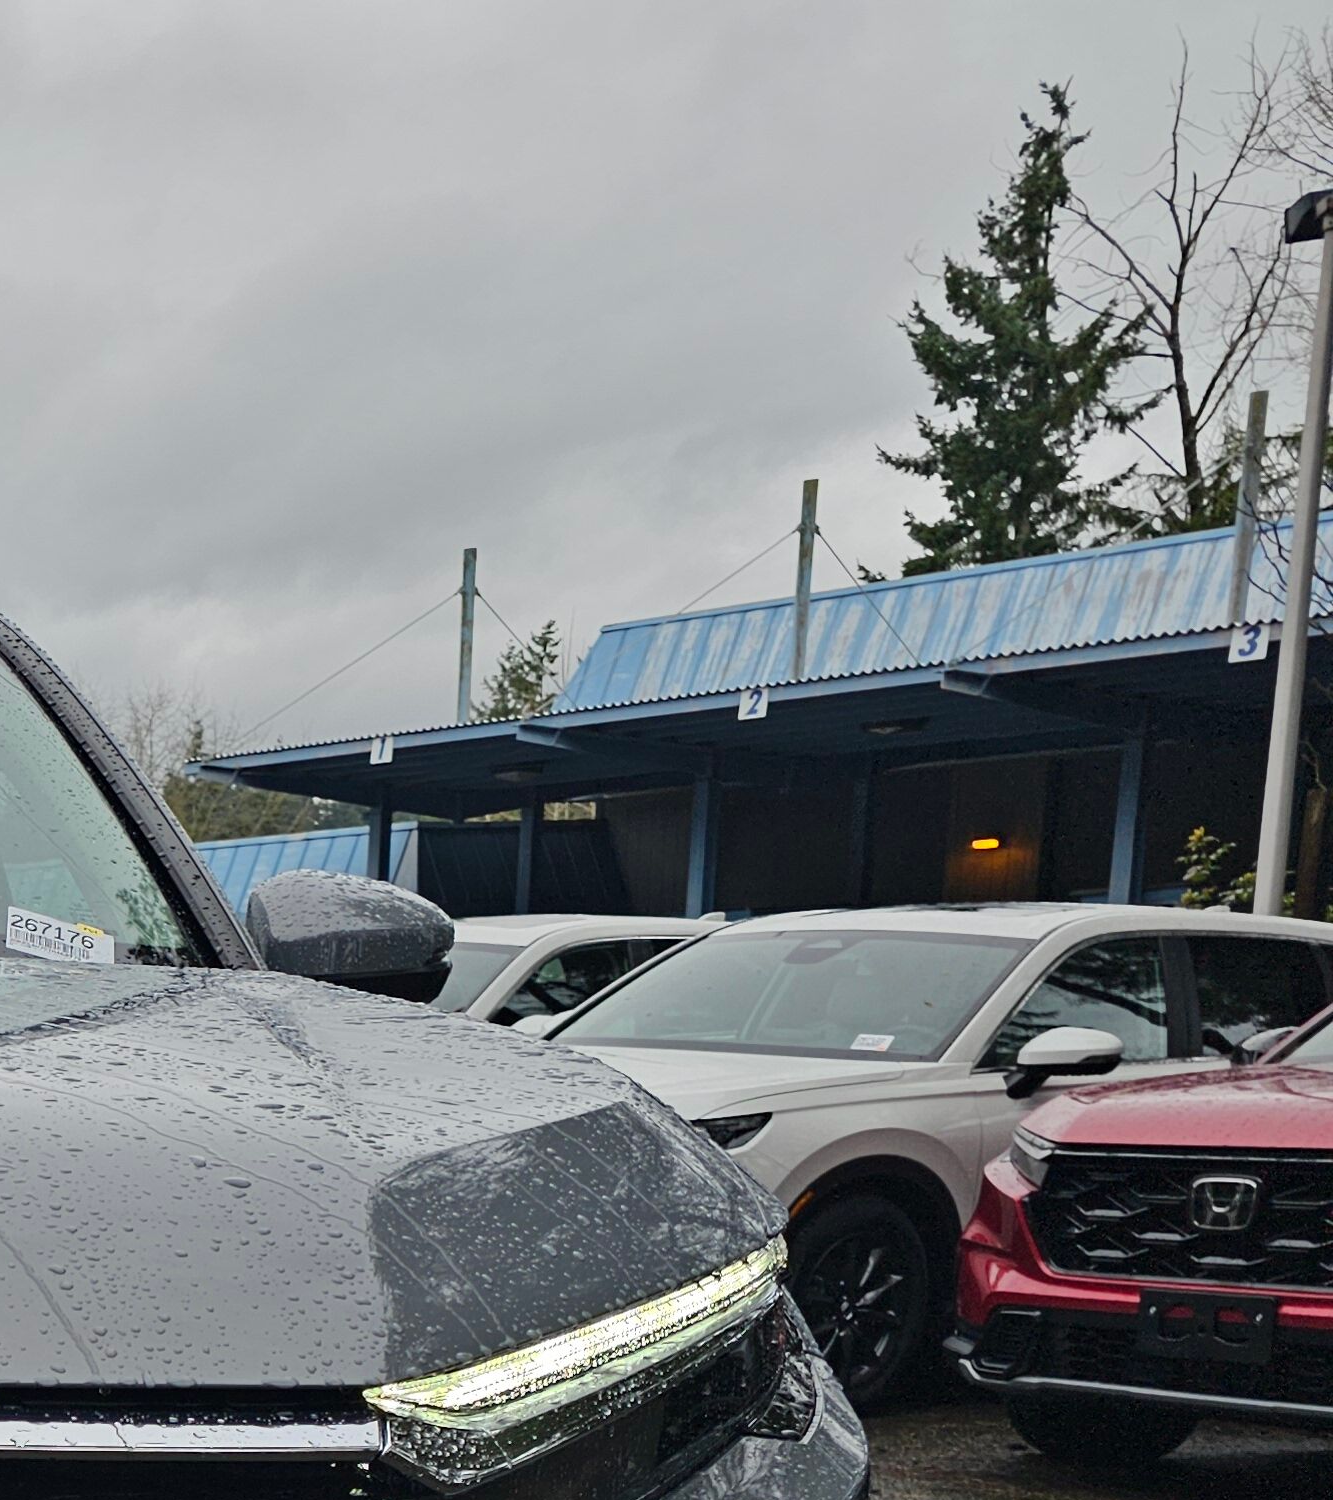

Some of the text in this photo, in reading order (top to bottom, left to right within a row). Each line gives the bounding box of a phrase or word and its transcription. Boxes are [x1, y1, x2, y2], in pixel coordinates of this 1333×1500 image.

[1237, 624, 1262, 657] 3
[746, 689, 763, 715] 2
[378, 735, 387, 760] 1
[10, 914, 95, 950] 267176
